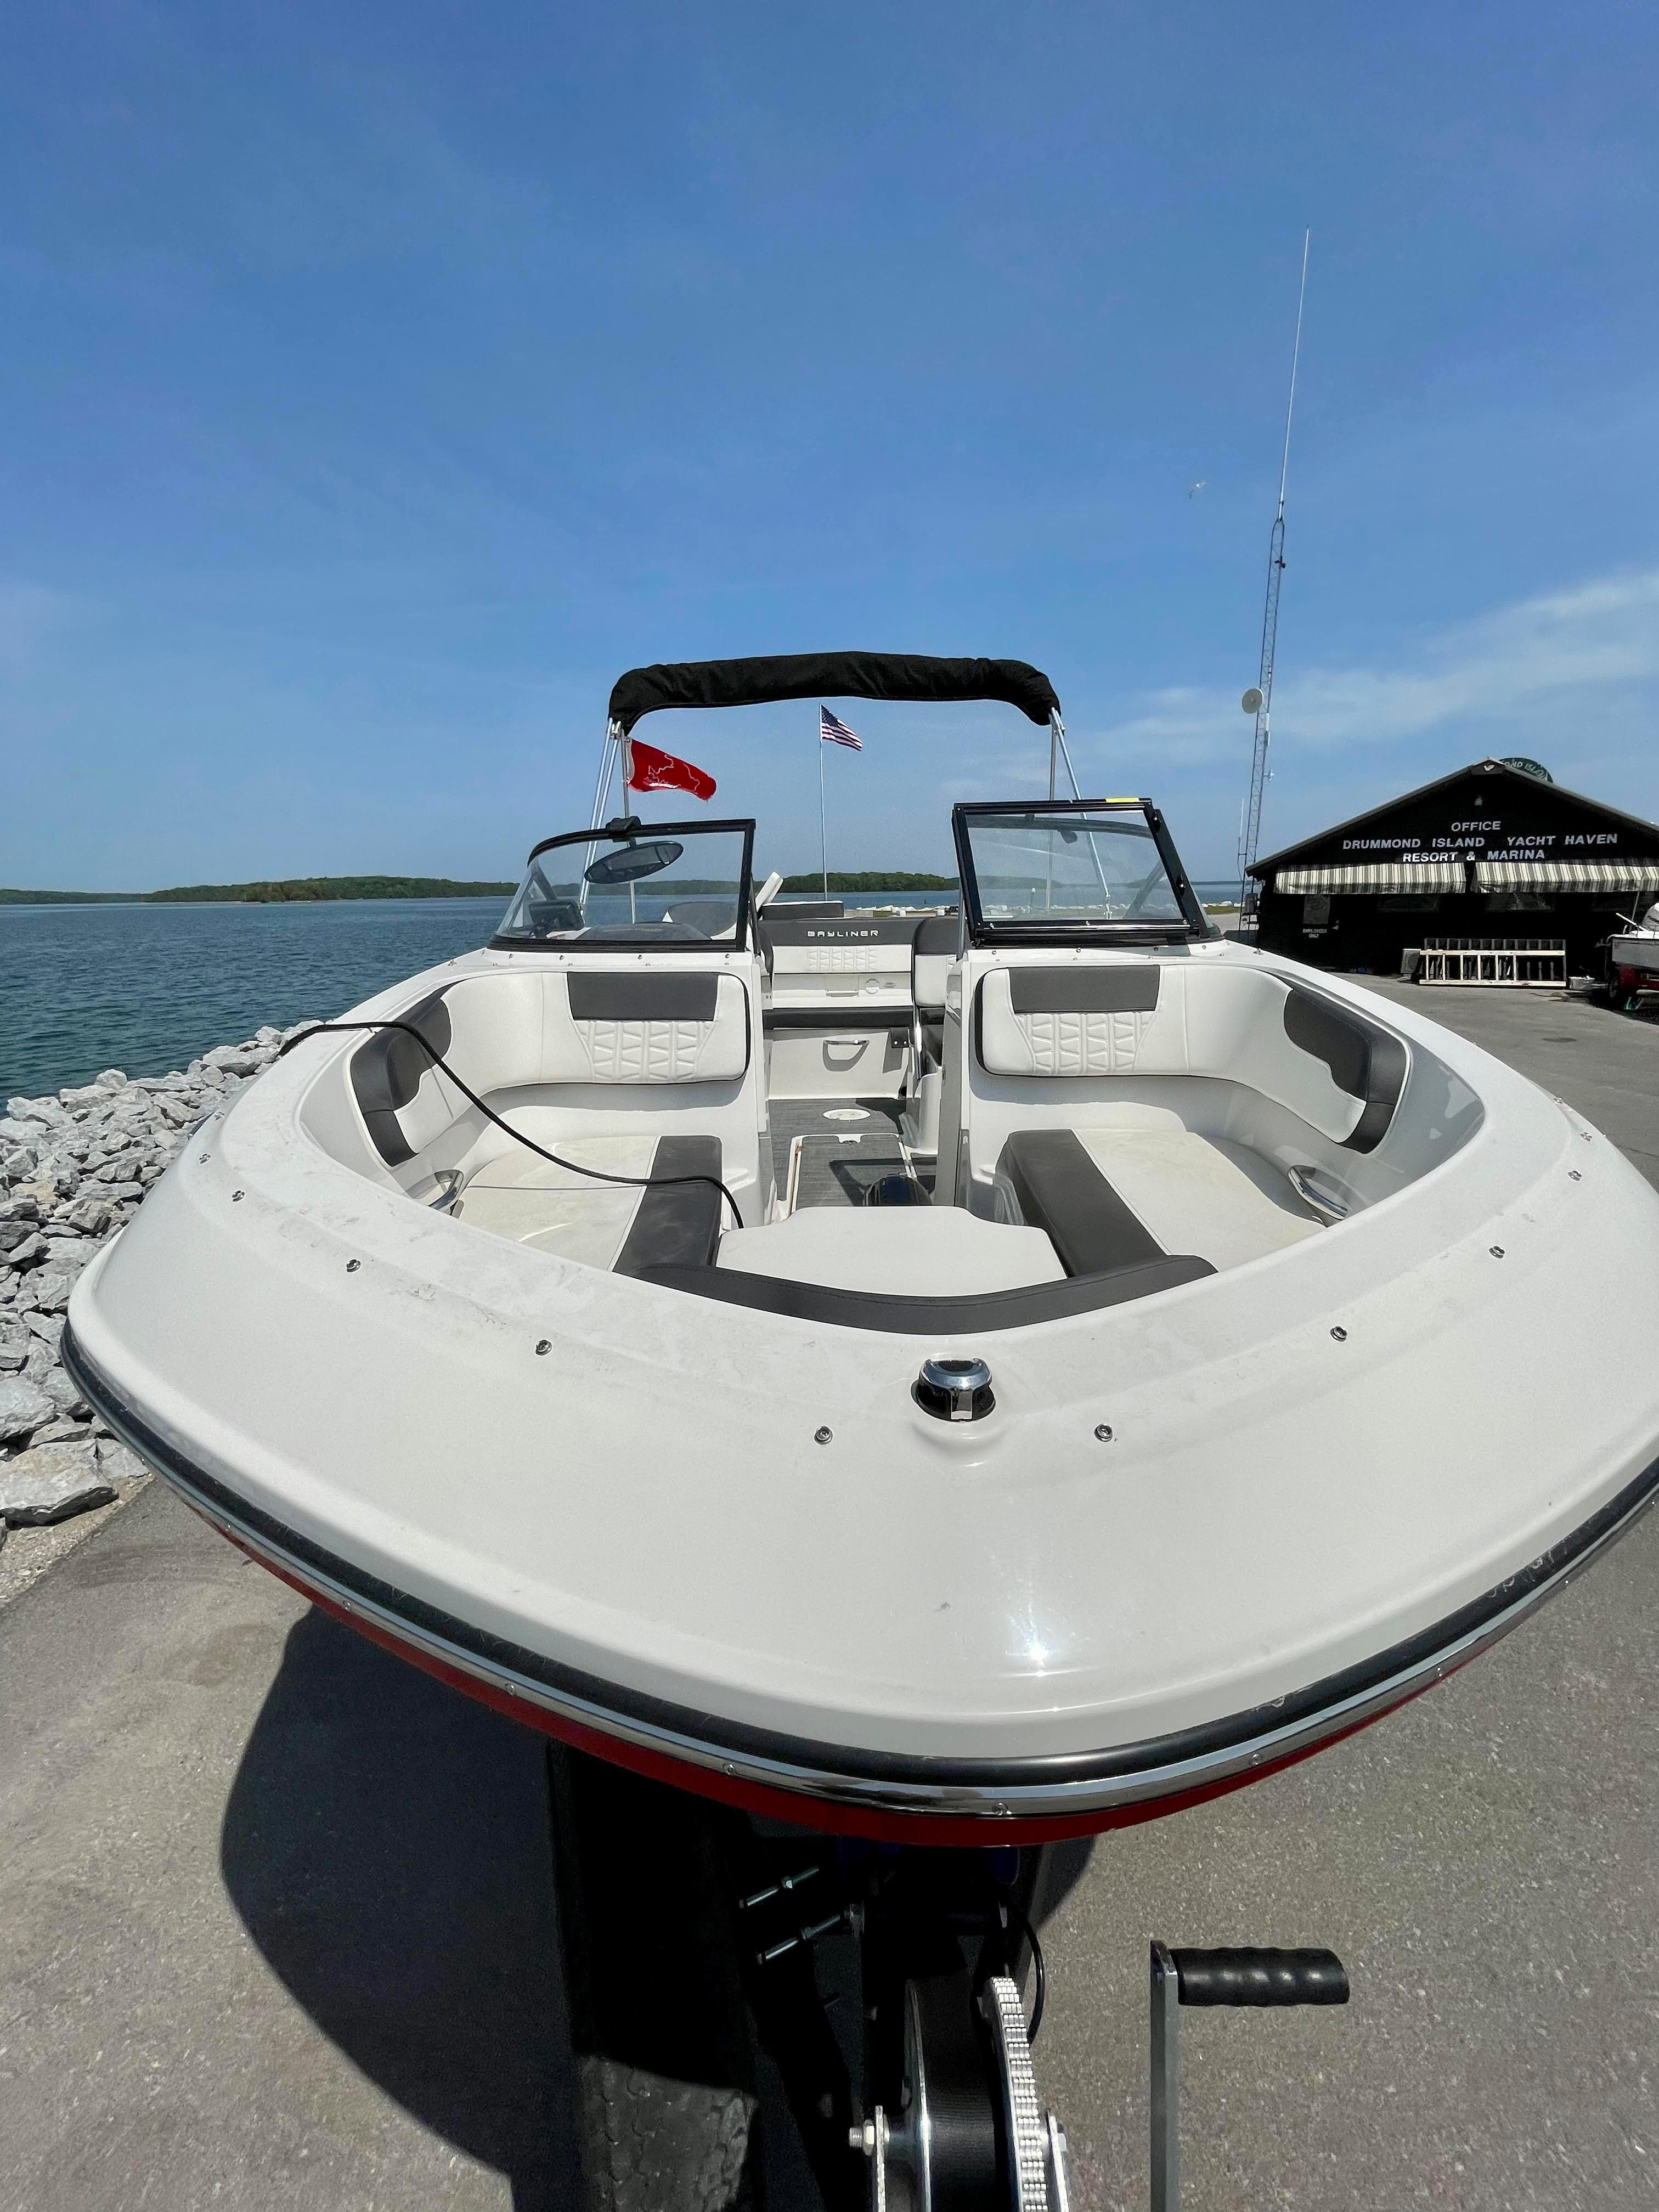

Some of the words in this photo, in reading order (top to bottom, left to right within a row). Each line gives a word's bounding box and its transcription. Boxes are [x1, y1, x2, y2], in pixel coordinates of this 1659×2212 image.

[1451, 821, 1501, 832] OFFICE
[1343, 838, 1421, 849] DRUMMOND
[1432, 837, 1485, 848] ISLAND
[1507, 835, 1556, 846] YACHT
[1565, 833, 1617, 845] HAVEN
[1403, 851, 1458, 862] RESORT
[1466, 851, 1475, 861] &
[1487, 849, 1545, 860] MARINA
